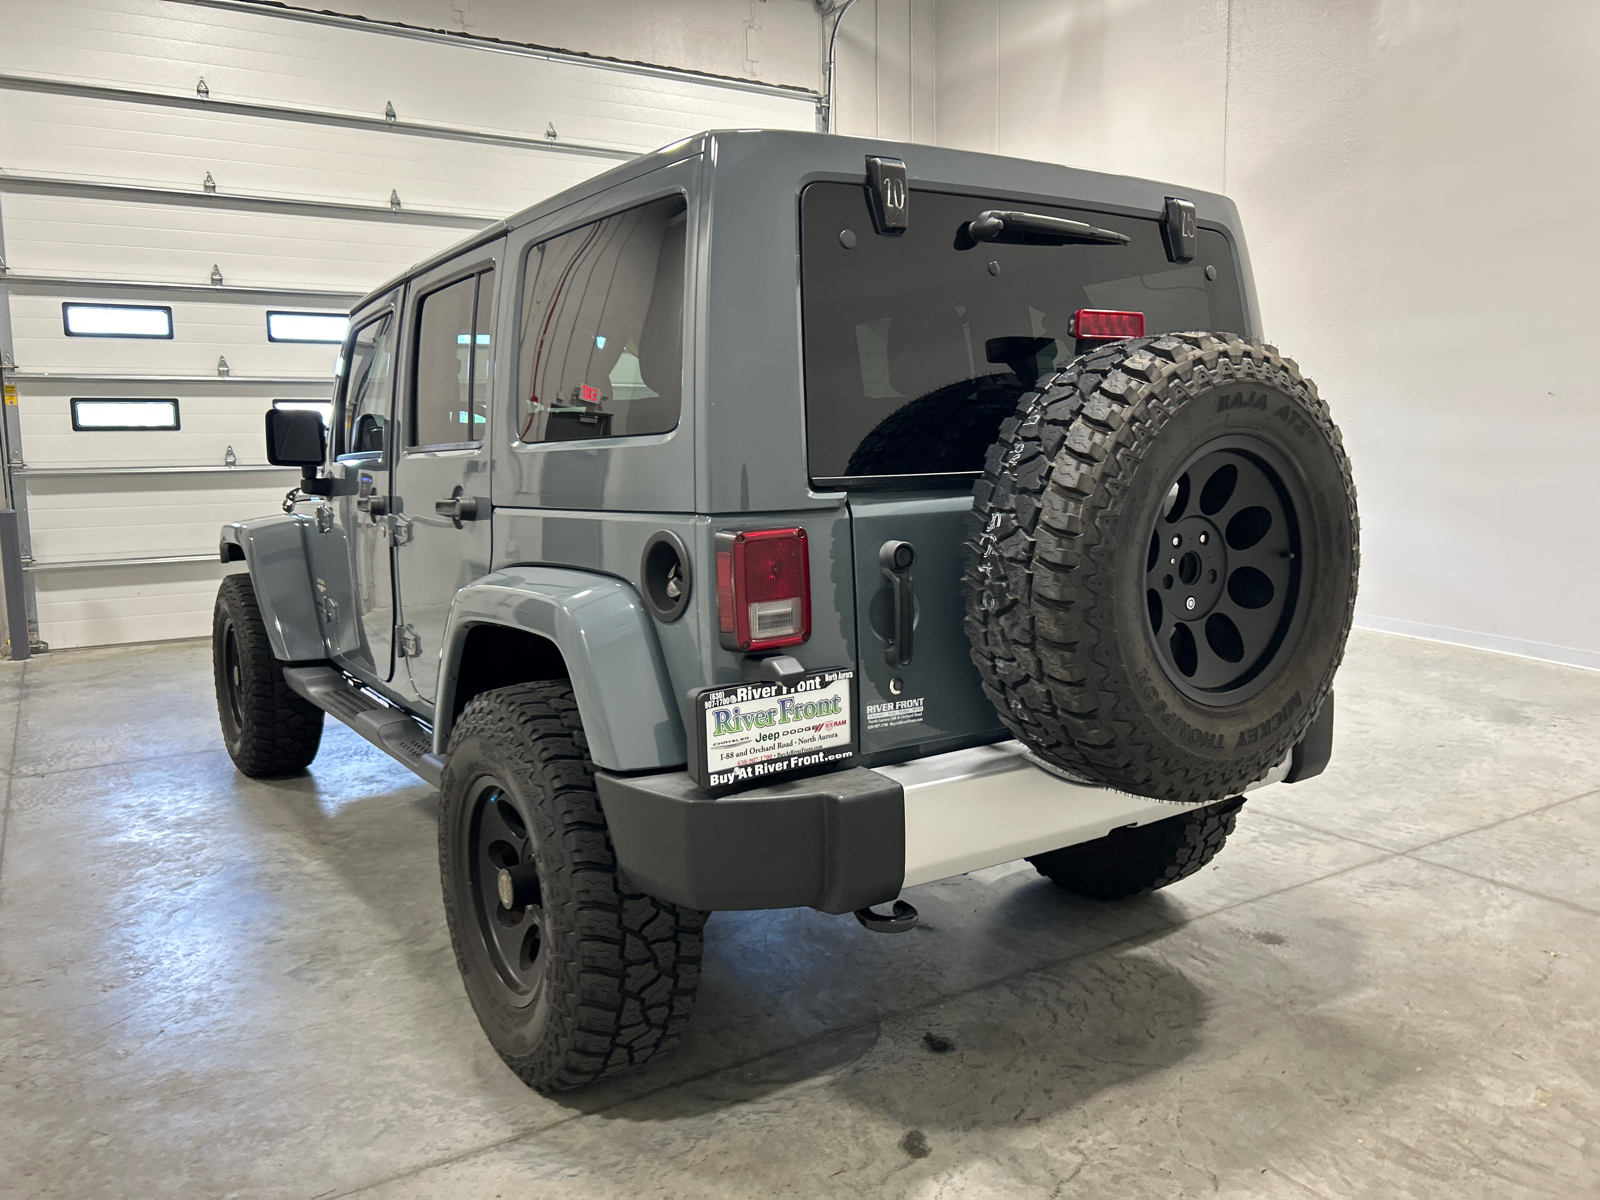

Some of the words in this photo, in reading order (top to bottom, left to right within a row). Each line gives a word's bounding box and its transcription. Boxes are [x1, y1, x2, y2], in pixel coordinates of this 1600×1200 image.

[1216, 391, 1268, 413] BAJA
[825, 672, 838, 682] North
[838, 671, 854, 680] Aurora
[737, 685, 778, 702] River
[866, 702, 894, 714] RIVER
[895, 697, 924, 710] FRONT
[1135, 668, 1224, 750] THOMPSON
[712, 707, 778, 737] River
[777, 694, 842, 725] Front
[834, 719, 847, 728] RAM
[1234, 690, 1302, 750] MICKEY
[755, 731, 780, 743] Jeep
[782, 725, 818, 737] DODGE
[720, 752, 734, 761] I-88
[735, 748, 748, 756] and
[749, 742, 776, 755] Orchard
[777, 740, 794, 750] Road
[798, 736, 817, 746] North
[818, 732, 838, 741] Aurora
[710, 771, 735, 786] Buy
[738, 766, 753, 780] At
[754, 760, 788, 776] River
[790, 752, 853, 768] Front.com
